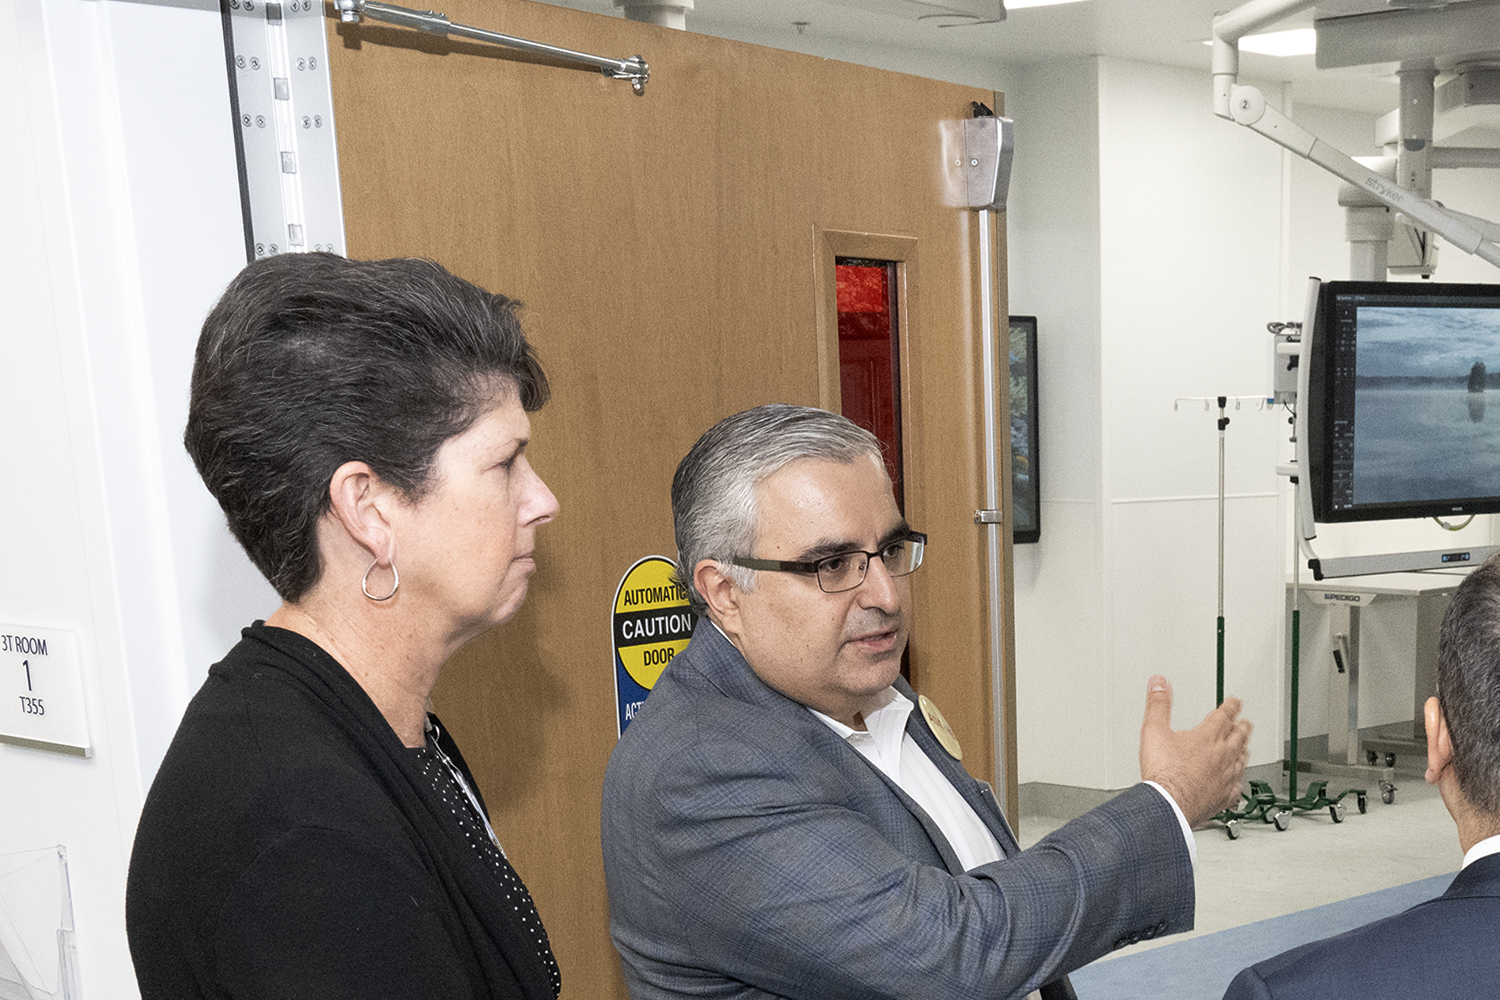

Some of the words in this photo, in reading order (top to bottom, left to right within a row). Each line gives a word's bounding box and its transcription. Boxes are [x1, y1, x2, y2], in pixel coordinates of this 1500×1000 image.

[1242, 101, 1248, 109] 2
[1365, 177, 1404, 202] stryker
[622, 613, 692, 639] CAUTION
[1, 635, 13, 651] 3T
[15, 635, 48, 656] ROOM
[643, 648, 675, 666] DOOR
[22, 660, 32, 691] 1
[19, 696, 45, 716] T355
